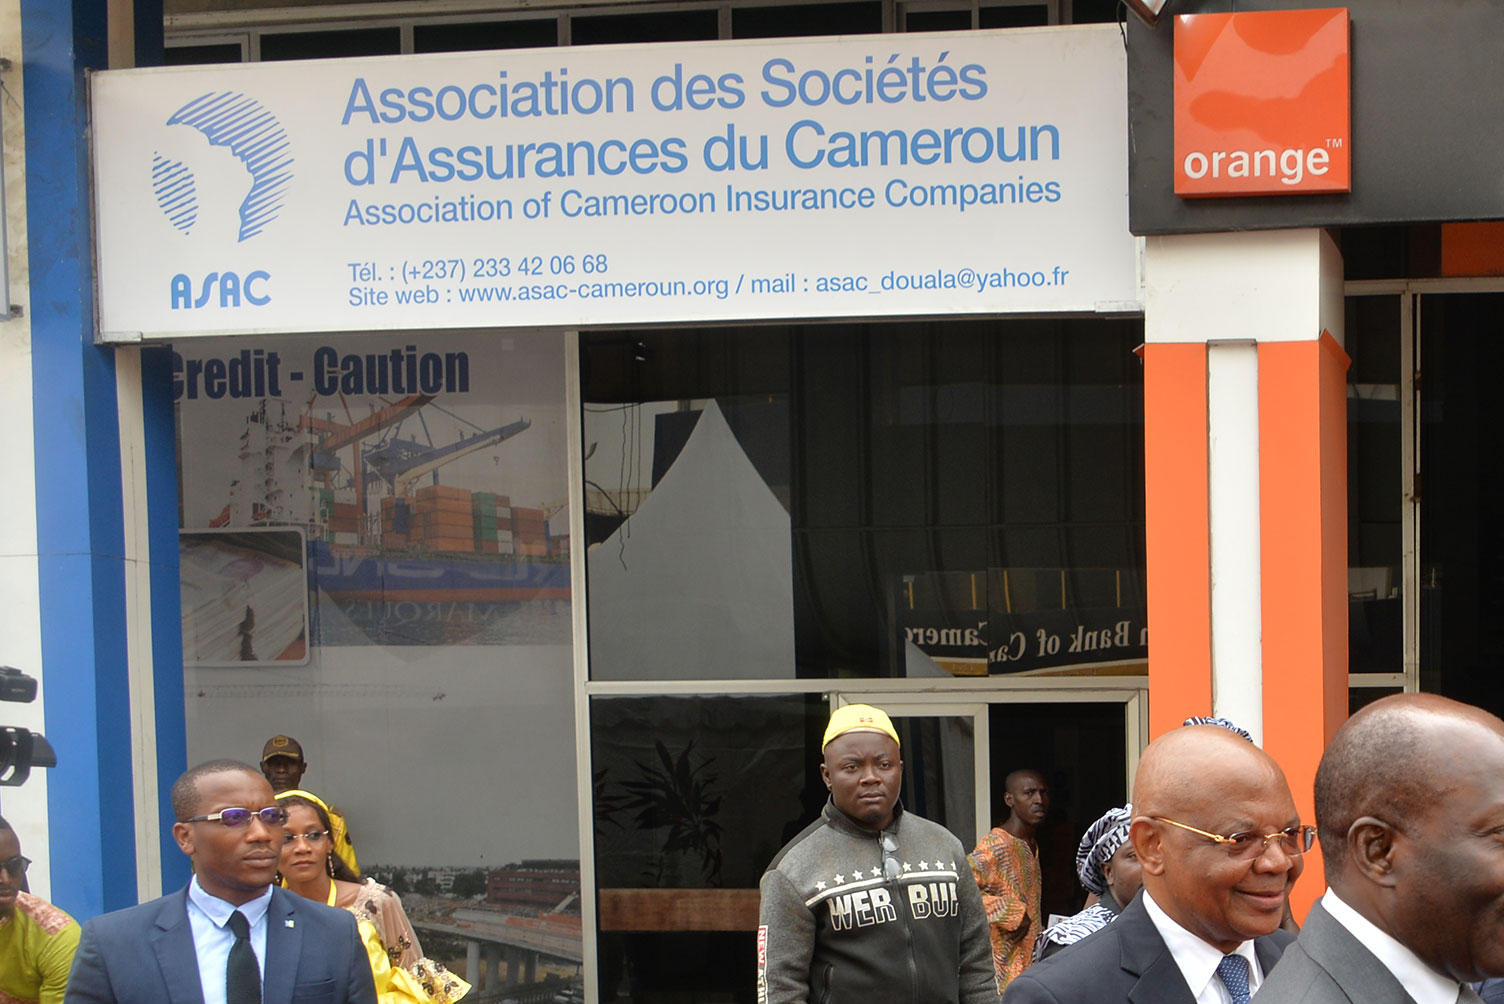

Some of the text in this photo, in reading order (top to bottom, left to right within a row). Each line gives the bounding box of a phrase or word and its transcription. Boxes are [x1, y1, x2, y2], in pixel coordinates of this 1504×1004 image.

[341, 51, 988, 126] Association des Sociétés
[343, 119, 1061, 187] d'Assurances du Cameroun
[1184, 147, 1330, 184] orange
[343, 175, 1062, 227] Association of Cameroon Insurance Companies
[170, 270, 272, 310] ASAC
[347, 262, 383, 282] Tél.
[401, 258, 467, 284] (+237)
[472, 256, 512, 278] 233
[517, 255, 544, 276] 42
[549, 254, 576, 275] 06
[581, 253, 609, 275] 68
[349, 286, 389, 307] Site
[394, 284, 440, 305] web
[458, 279, 729, 303] www.asac-cameroun.org
[751, 272, 796, 294] mail
[815, 265, 1070, 295] asac_douala@yahoo.fr
[313, 345, 470, 397] Caution
[826, 887, 897, 931] WER
